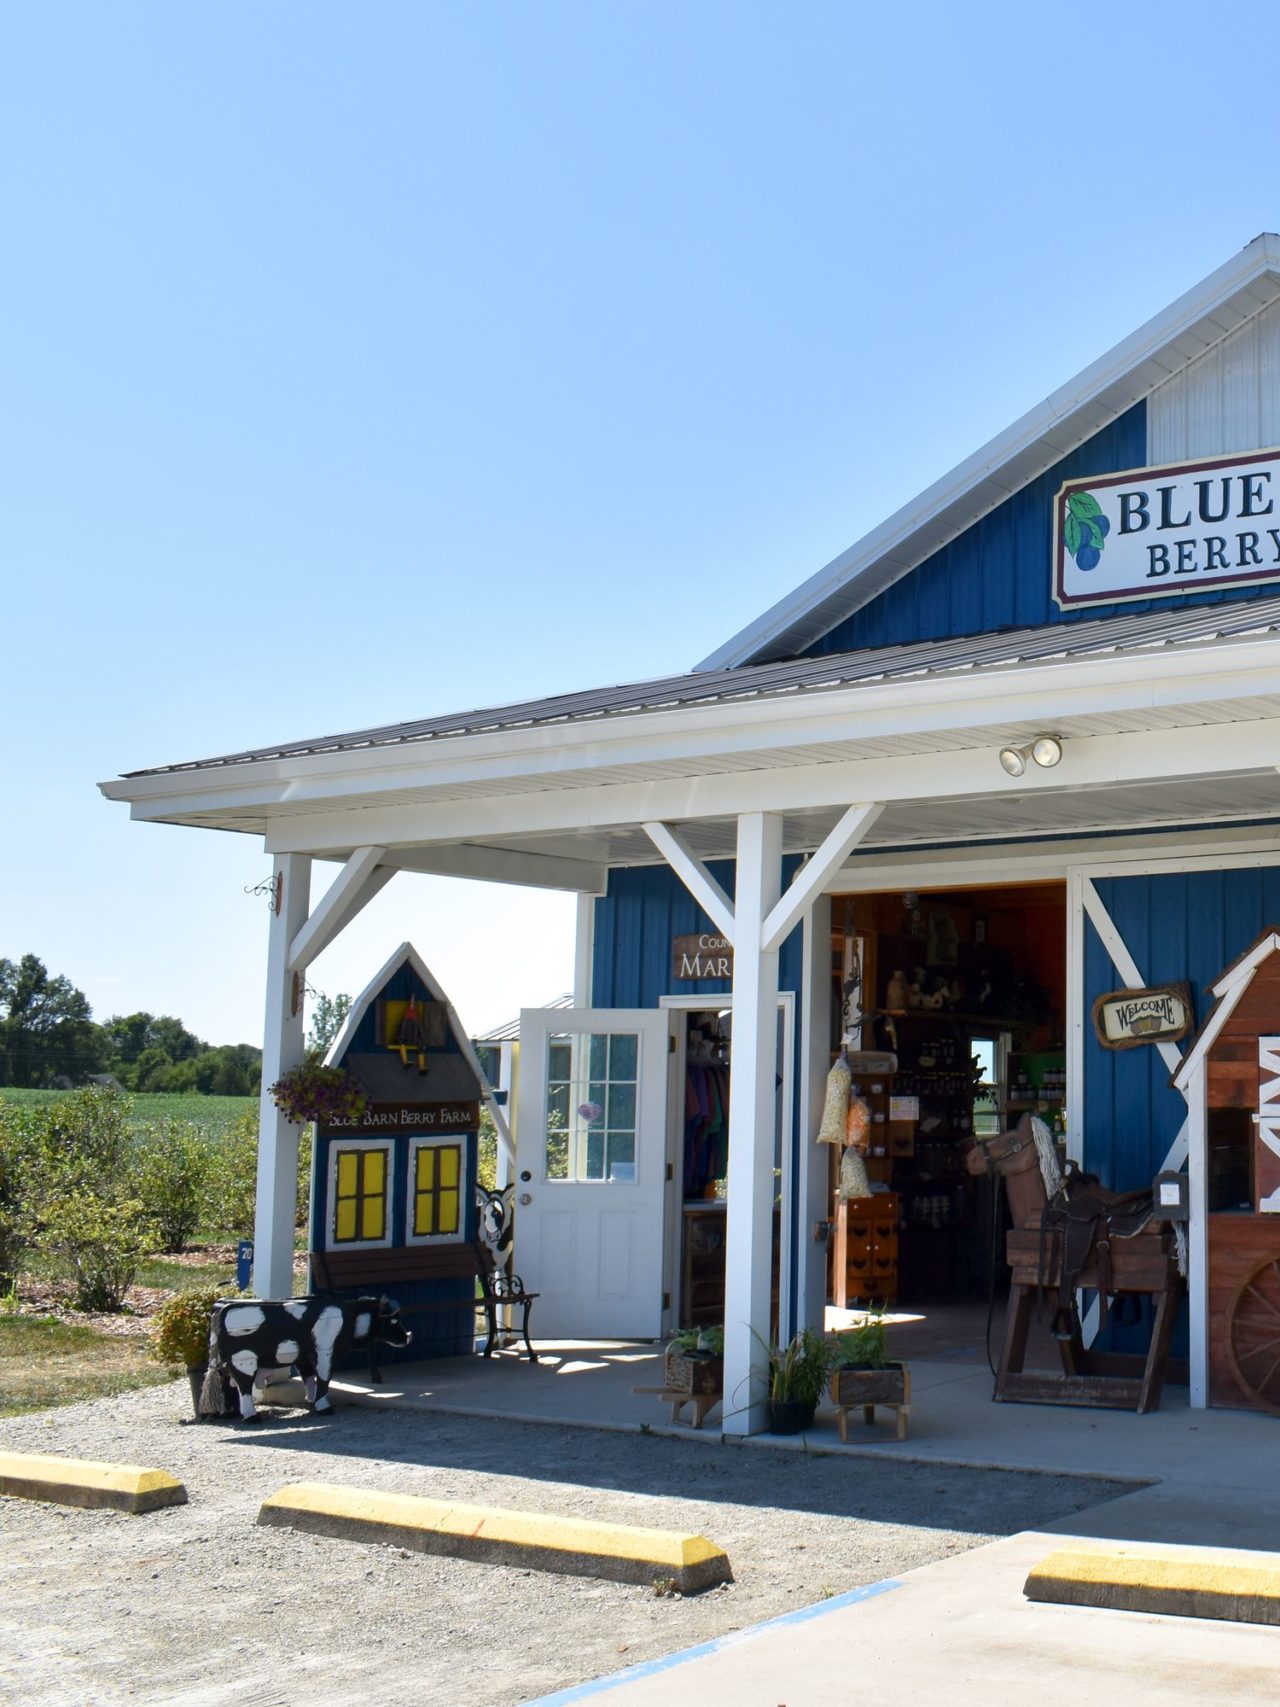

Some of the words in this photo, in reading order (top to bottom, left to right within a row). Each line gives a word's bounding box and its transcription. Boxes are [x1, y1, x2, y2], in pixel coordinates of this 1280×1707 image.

[1117, 471, 1273, 536] BLUE
[680, 953, 731, 977] MAR
[1116, 997, 1175, 1031] WELCOME
[364, 1110, 398, 1126] BARN
[401, 1109, 436, 1125] BERRY
[440, 1108, 471, 1124] FARM
